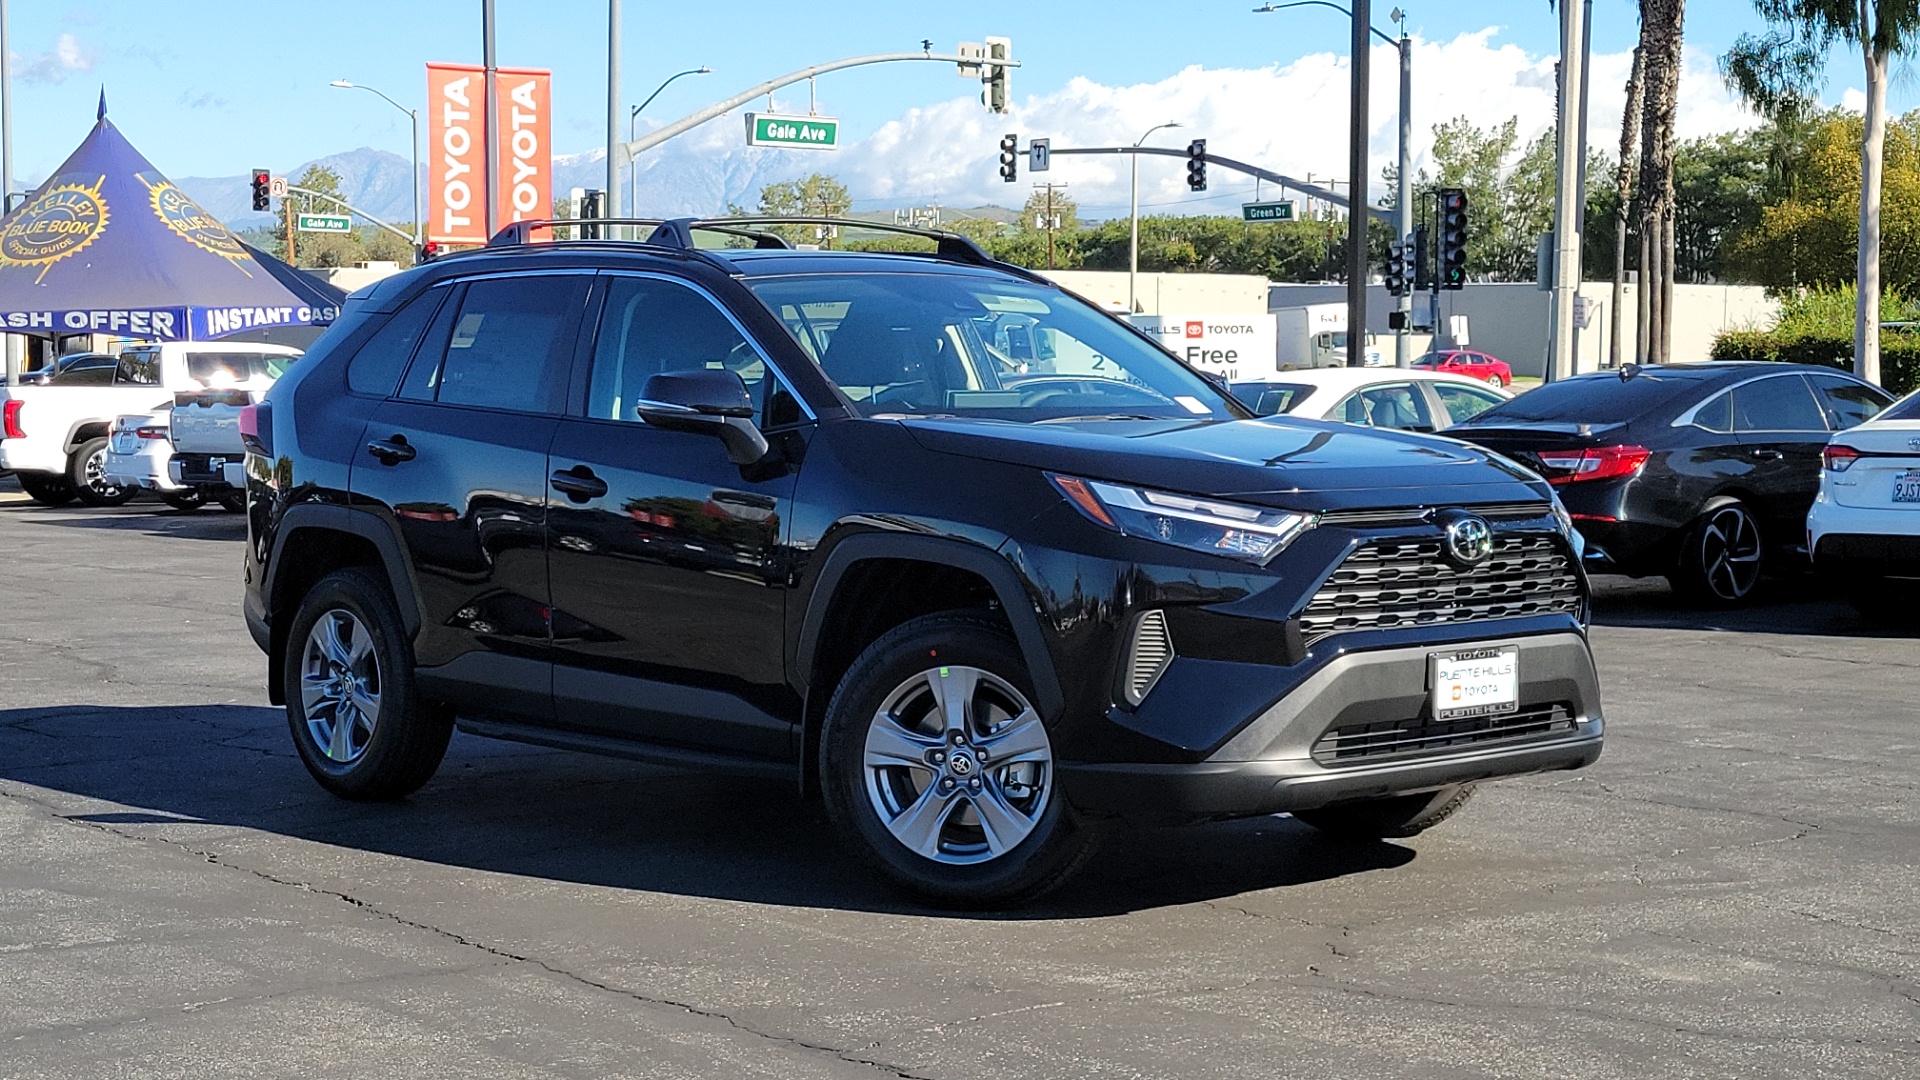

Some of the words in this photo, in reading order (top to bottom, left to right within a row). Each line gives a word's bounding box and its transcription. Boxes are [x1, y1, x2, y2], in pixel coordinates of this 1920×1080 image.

[767, 122, 797, 139] Gale
[799, 124, 826, 141] Ave
[443, 76, 471, 233] TOYOTA
[29, 193, 96, 217] KELLEY
[1250, 208, 1274, 218] Green
[1275, 206, 1286, 217] Dr
[7, 220, 49, 237] BLUE
[46, 219, 94, 235] BOOK
[306, 218, 325, 228] Gale
[326, 219, 344, 229] Ave
[40, 237, 75, 254] GUIDE
[64, 311, 174, 338] OFFER
[207, 307, 292, 336] INSTANT
[1143, 325, 1181, 334] HILLS
[1207, 325, 1254, 334] TOYOTA
[1091, 354, 1105, 371] 2
[1186, 346, 1238, 364] Free
[1219, 369, 1238, 379] All
[1457, 649, 1500, 660] TOYOTA
[1482, 664, 1512, 676] HILLS
[1464, 684, 1498, 696] TOYOTA
[1484, 703, 1514, 713] HILLS
